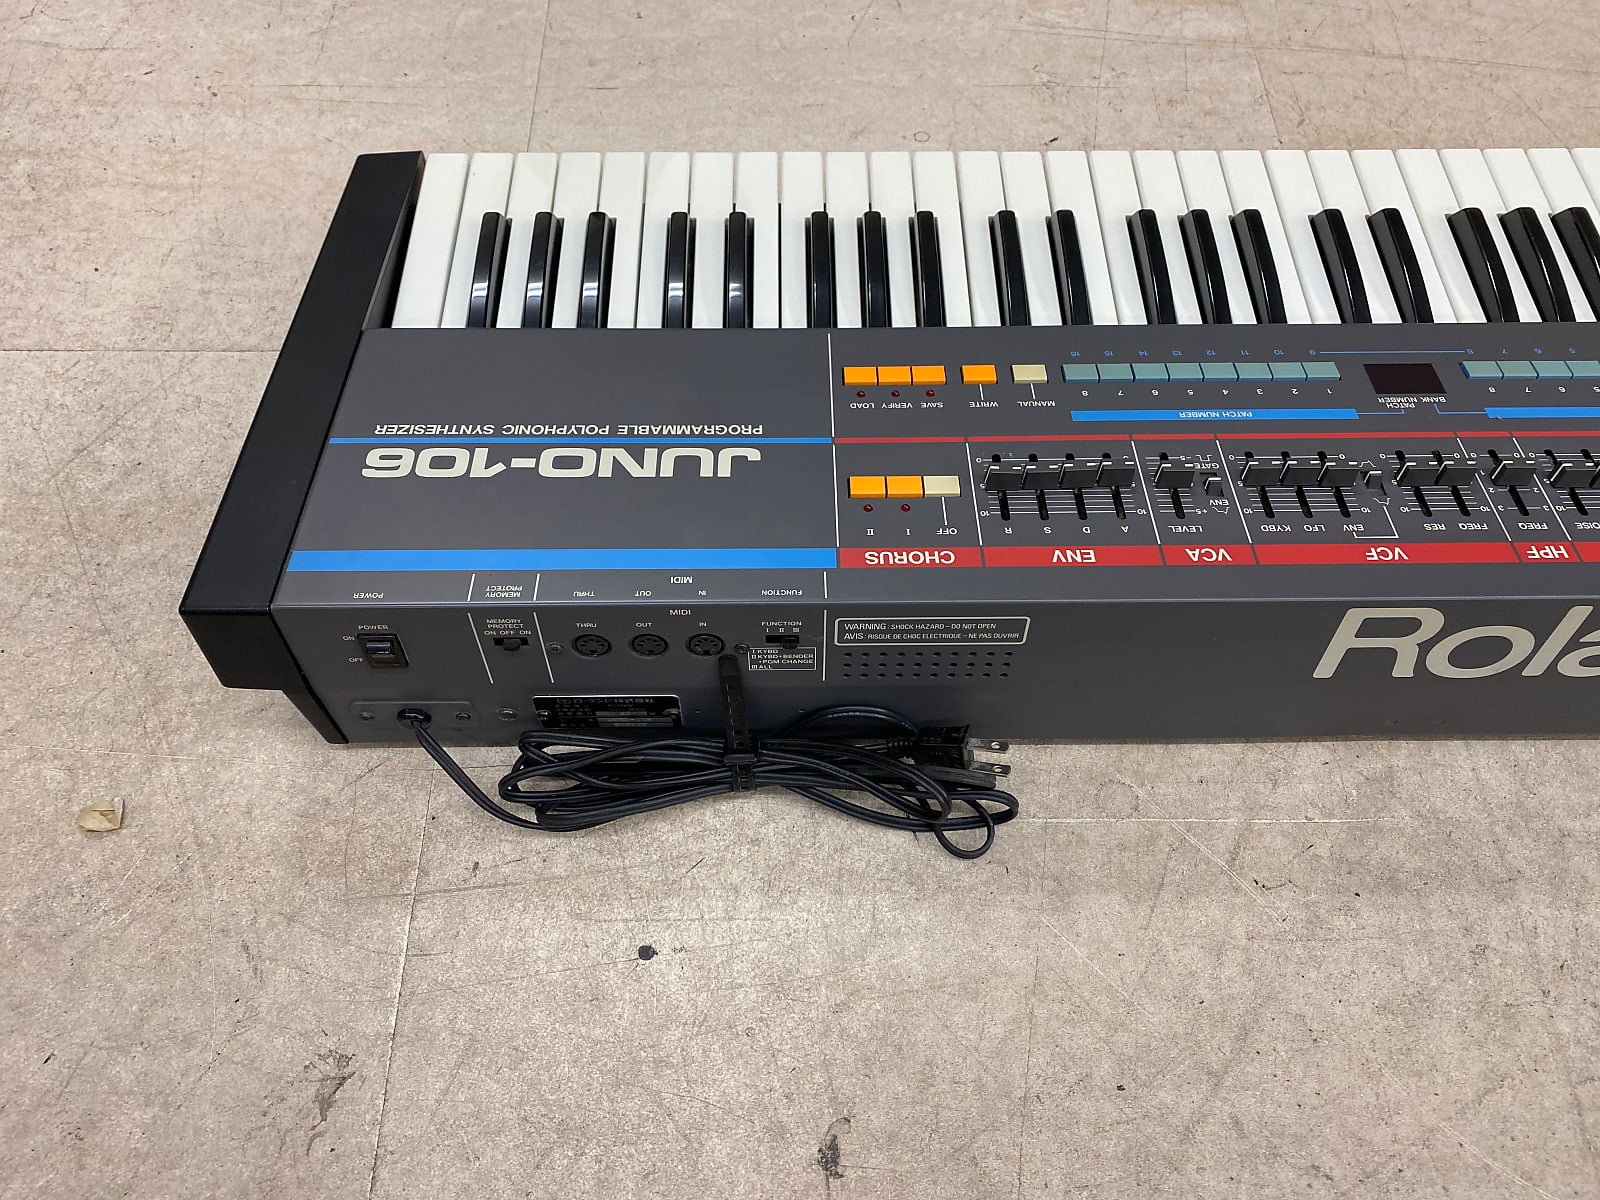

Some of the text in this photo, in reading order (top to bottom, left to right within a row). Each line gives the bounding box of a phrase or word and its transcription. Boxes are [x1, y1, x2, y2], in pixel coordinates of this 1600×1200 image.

[374, 424, 764, 436] PROGRAMMABLE POLYPHONIC SYNTHESIZER
[361, 447, 762, 478] JUNO-106
[1458, 522, 1488, 530] FREQ
[1518, 522, 1548, 530] FREQ
[864, 550, 956, 565] CHORUS
[1052, 549, 1096, 563] ENV
[1185, 548, 1232, 562] VCA
[1366, 547, 1408, 561] VCF
[1526, 546, 1570, 559] HPF
